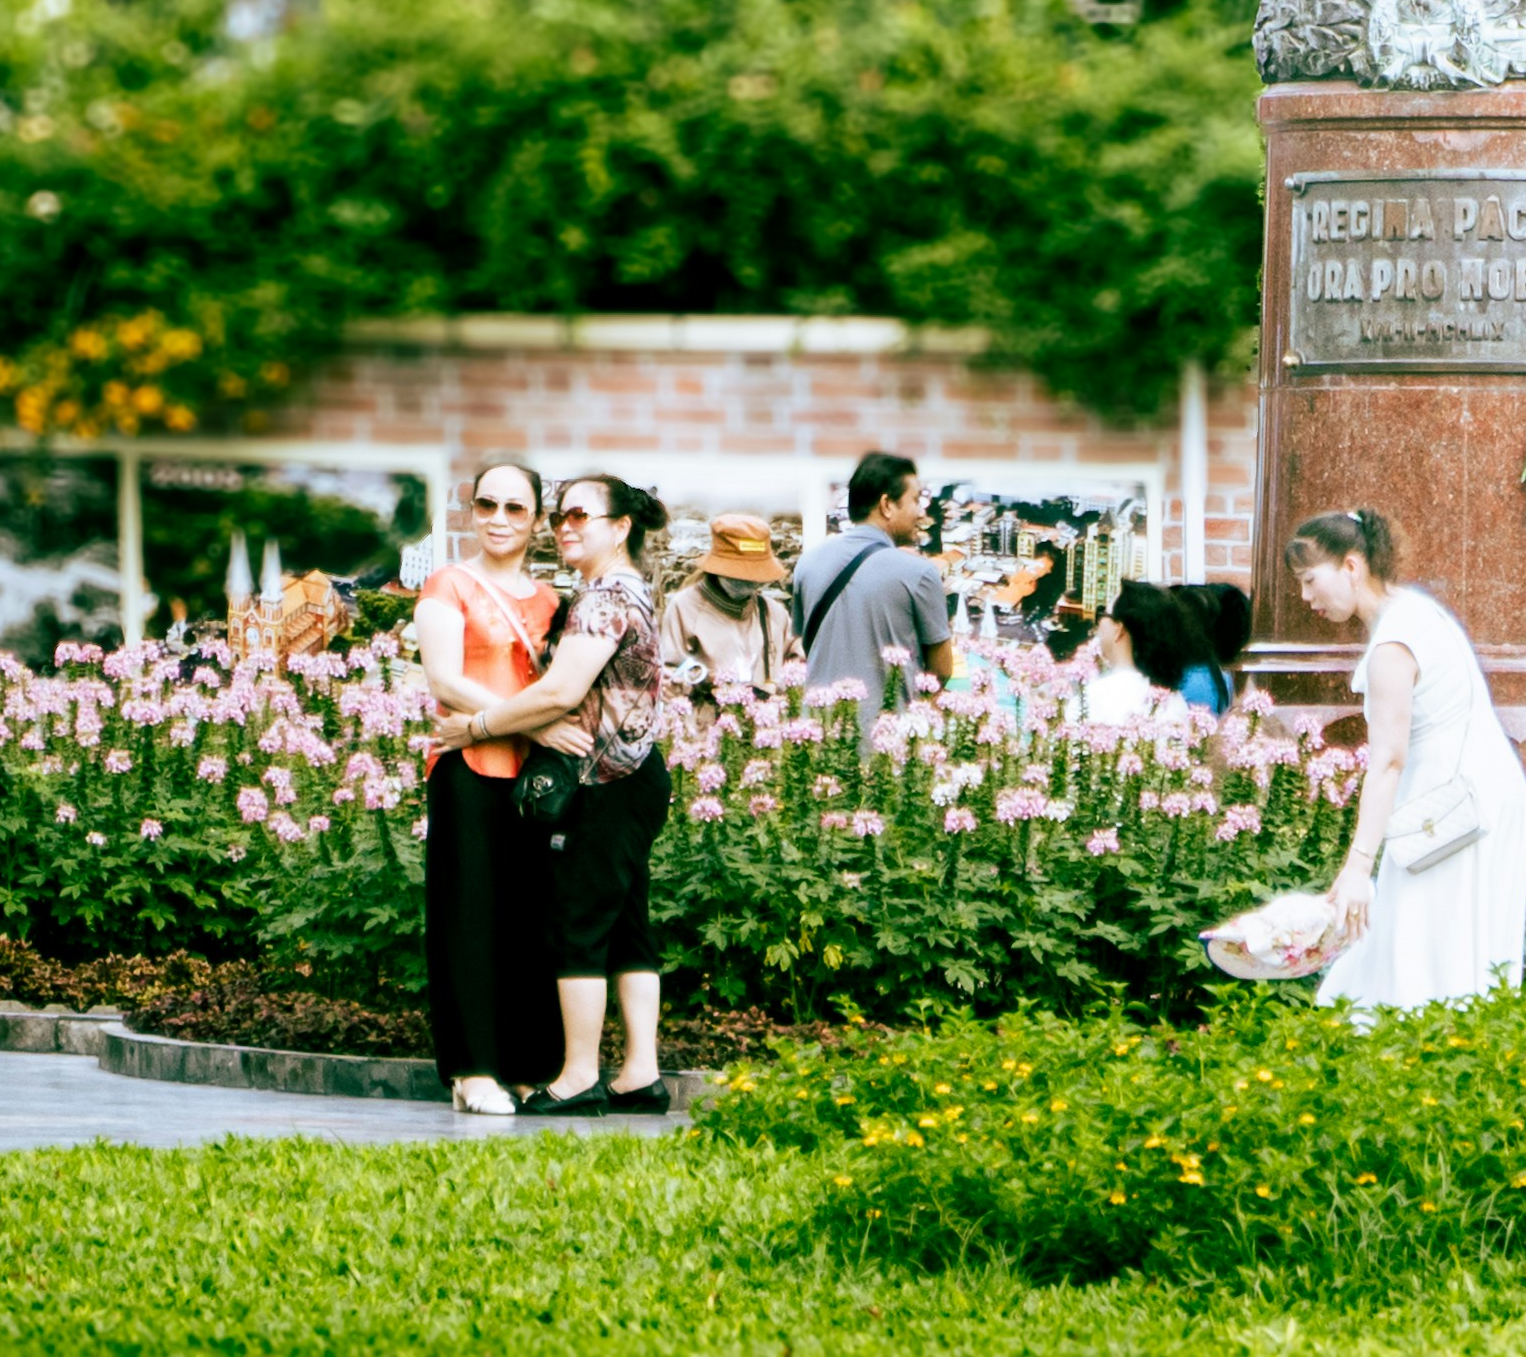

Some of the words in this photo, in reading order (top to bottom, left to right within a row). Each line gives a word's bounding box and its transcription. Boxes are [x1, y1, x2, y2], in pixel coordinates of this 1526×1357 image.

[1312, 198, 1435, 242] REGINA
[1306, 257, 1363, 302] ORA
[1371, 257, 1447, 302] PRO
